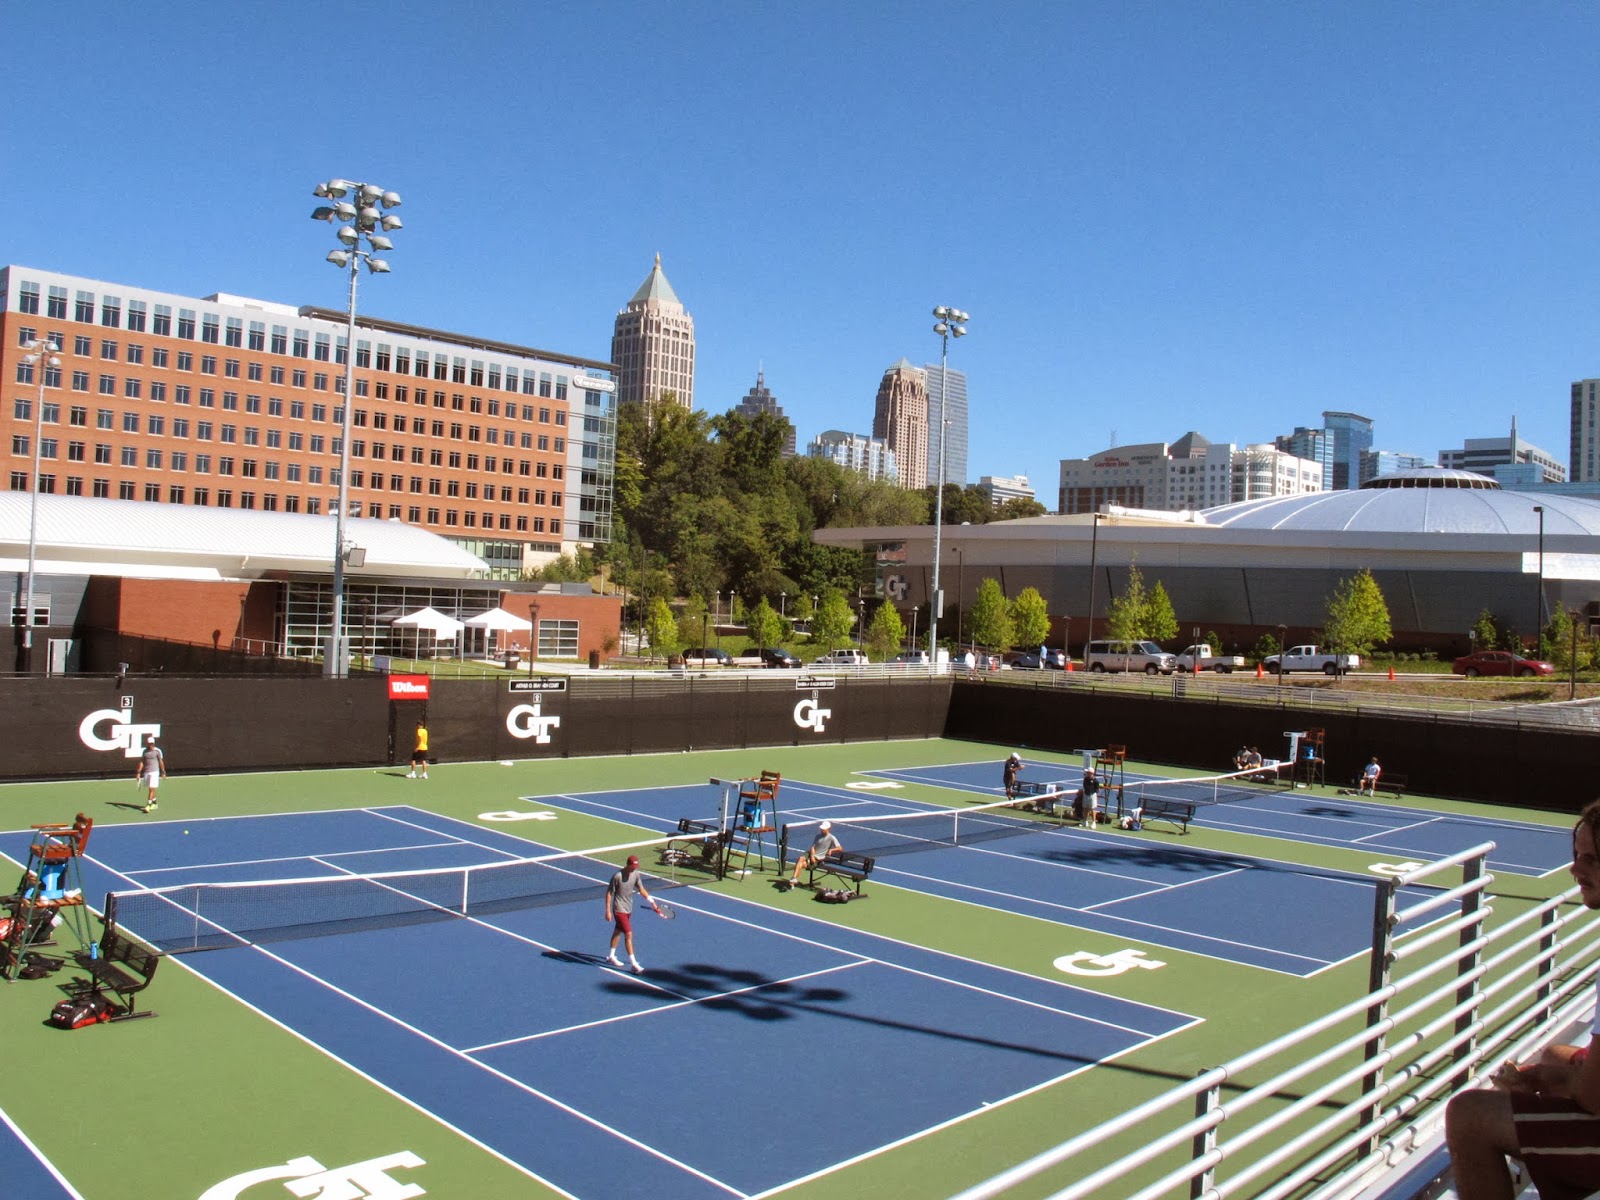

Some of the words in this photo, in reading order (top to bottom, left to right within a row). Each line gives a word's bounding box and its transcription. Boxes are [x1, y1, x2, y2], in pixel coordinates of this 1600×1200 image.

[124, 697, 131, 706] 3
[391, 681, 427, 693] Wilson
[506, 704, 560, 744] GT
[793, 699, 832, 732] GT
[80, 709, 161, 758] GT
